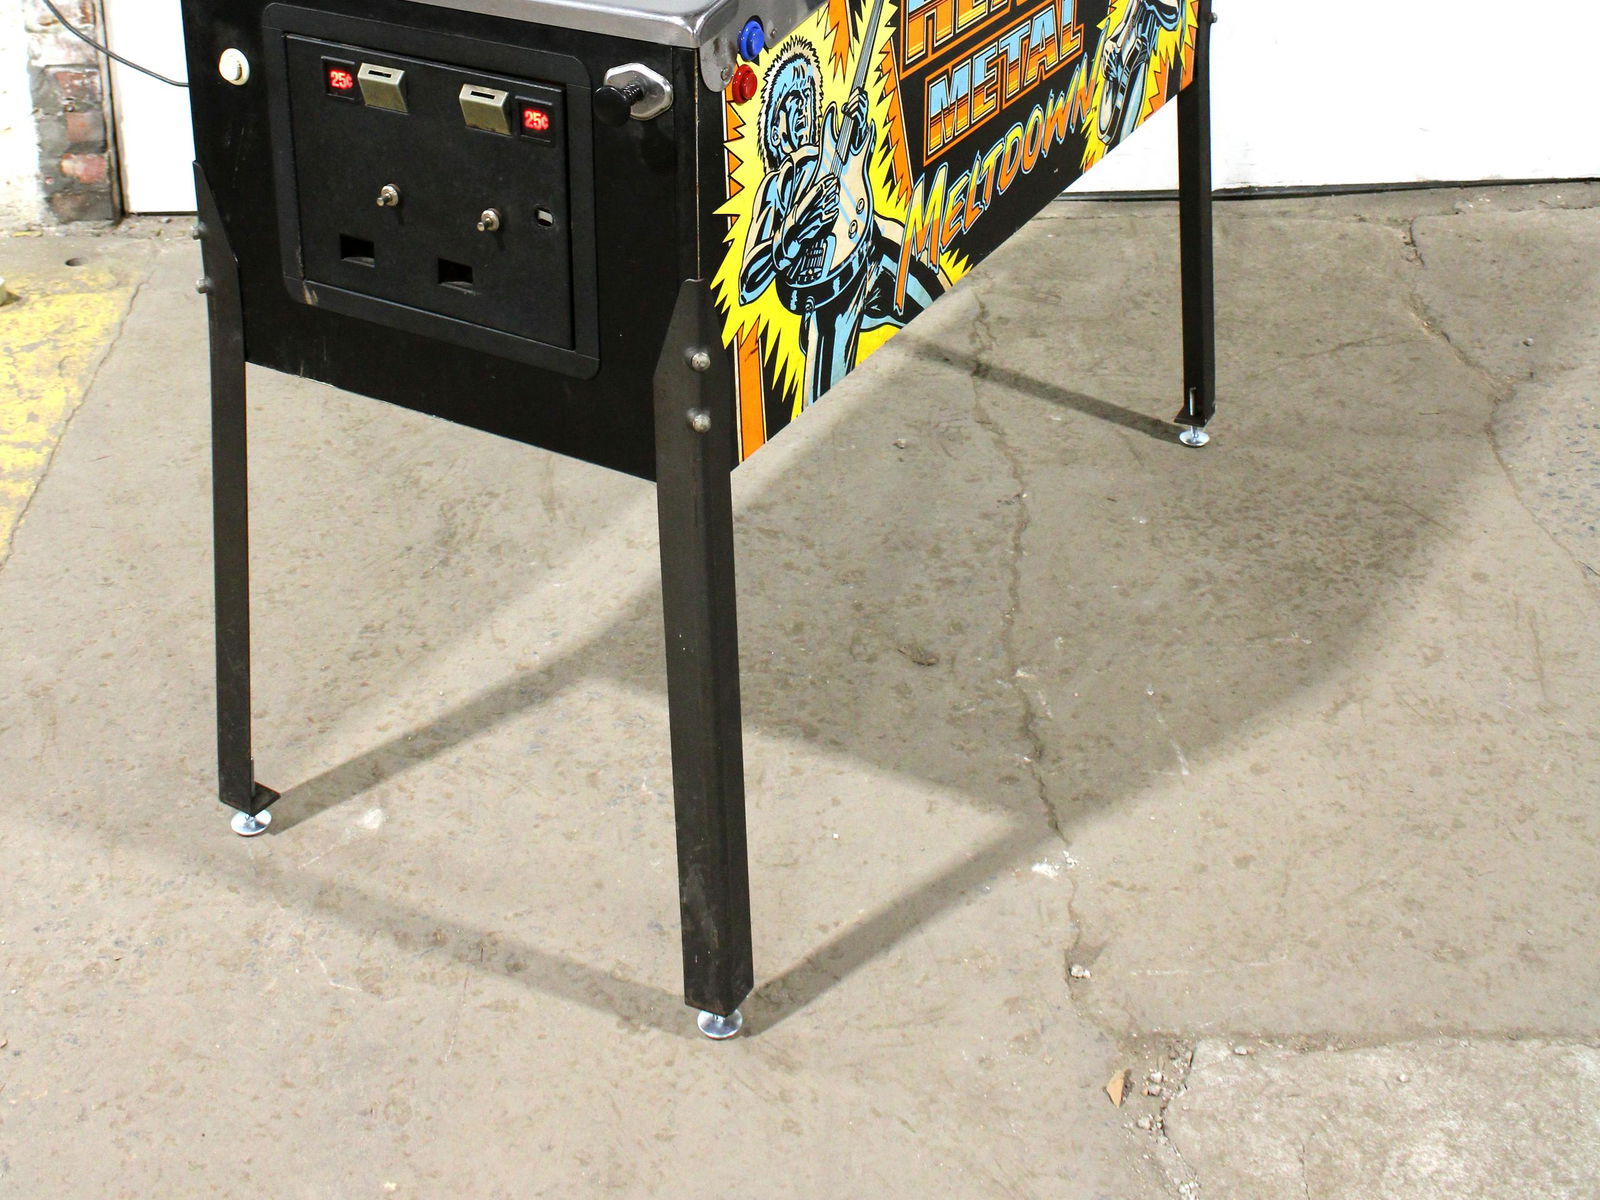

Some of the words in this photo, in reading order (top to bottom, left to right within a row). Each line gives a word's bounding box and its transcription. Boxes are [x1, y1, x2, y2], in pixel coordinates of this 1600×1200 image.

[328, 68, 354, 90] 25¢
[523, 108, 550, 131] 25¢
[896, 21, 1110, 311] MELTDOWN
